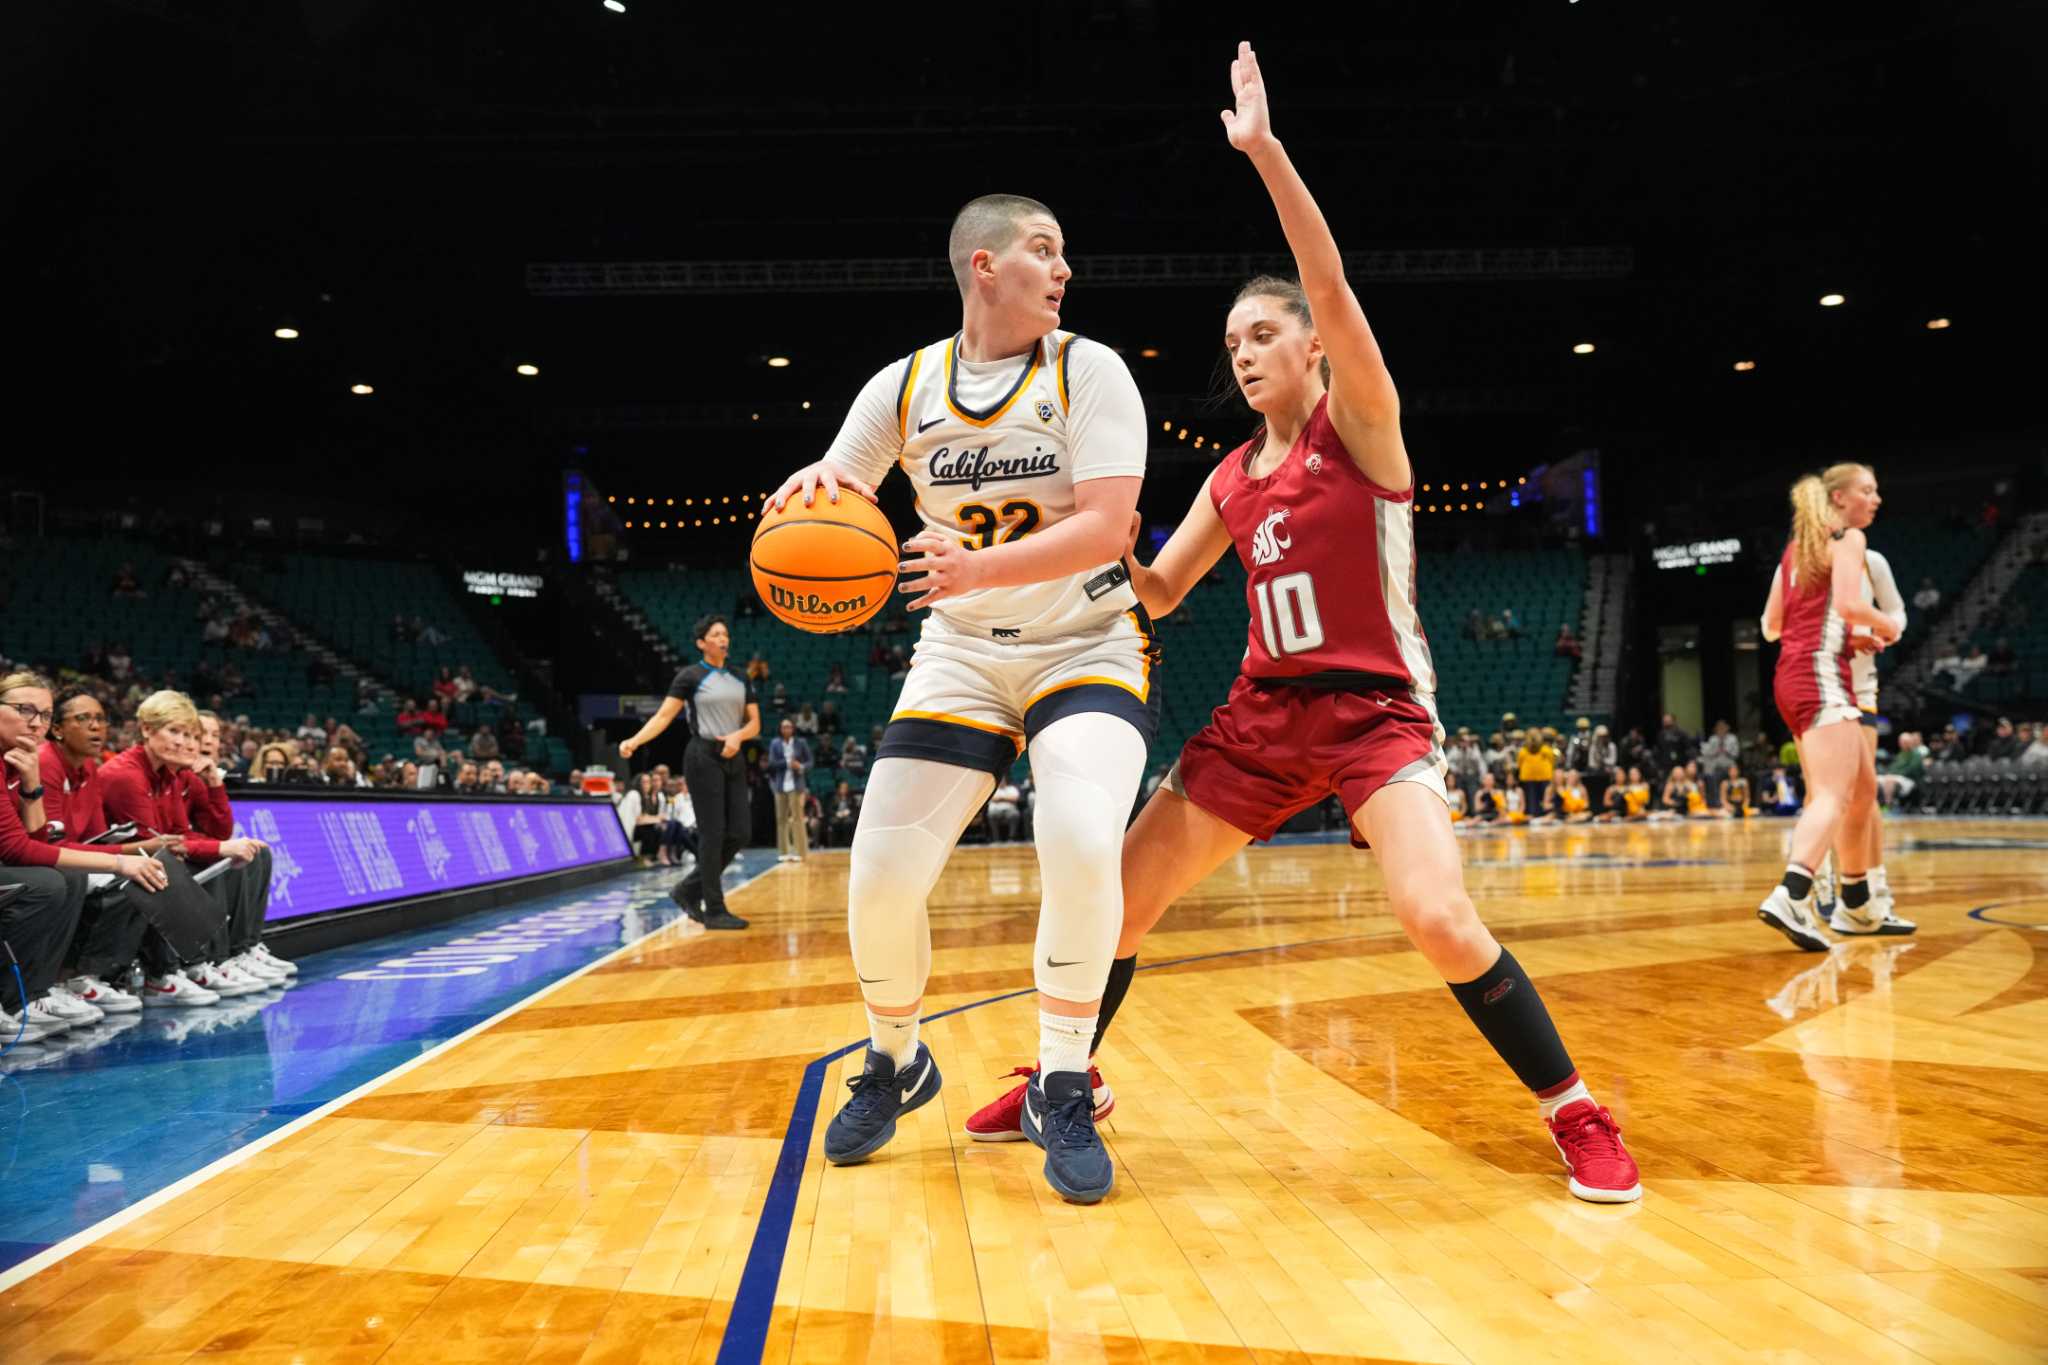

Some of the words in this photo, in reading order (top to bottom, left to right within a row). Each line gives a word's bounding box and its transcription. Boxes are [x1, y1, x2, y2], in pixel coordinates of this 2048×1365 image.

[929, 446, 1060, 491] California
[955, 498, 1042, 551] 32
[769, 583, 867, 615] Wilson
[1255, 571, 1325, 662] 10
